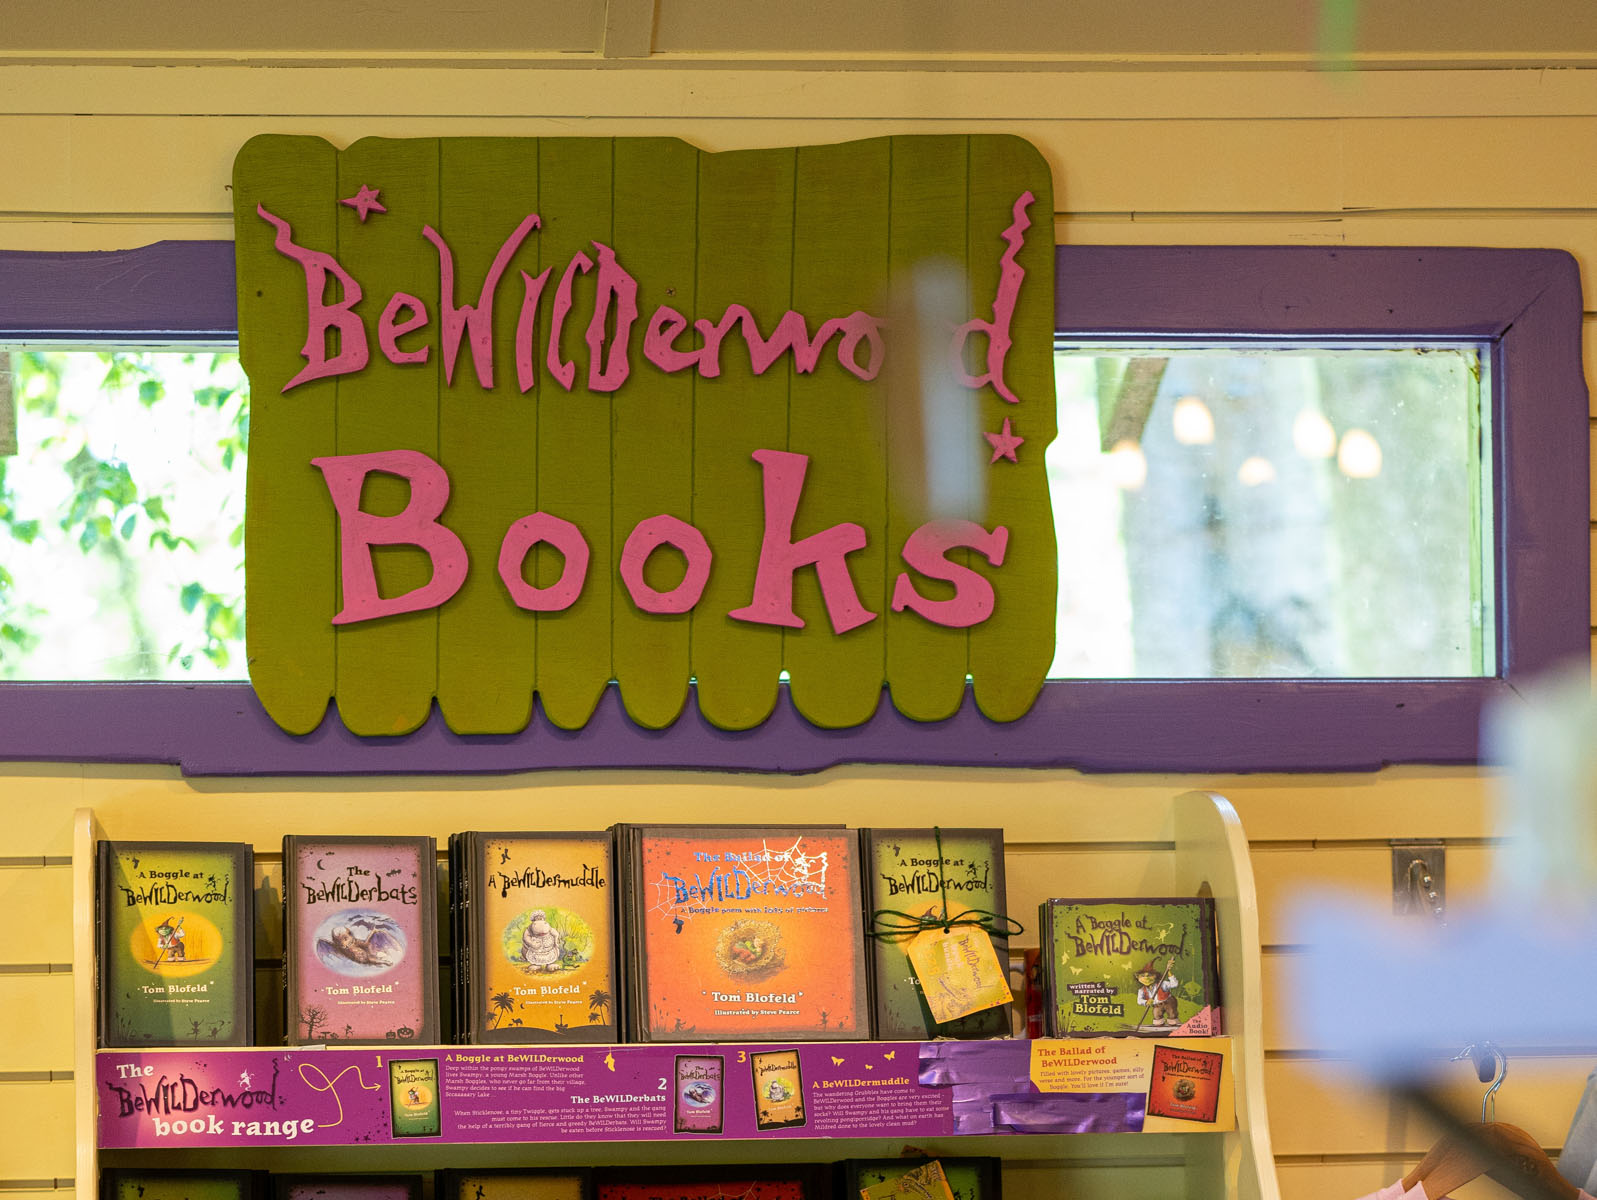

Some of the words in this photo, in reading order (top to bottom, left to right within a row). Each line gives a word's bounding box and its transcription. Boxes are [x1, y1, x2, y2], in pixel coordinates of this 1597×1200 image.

[257, 191, 1037, 402] BeWILDerwod
[311, 449, 1009, 636] Books
[694, 852, 720, 862] The
[149, 870, 190, 880] Boggle
[347, 866, 370, 876] The
[488, 875, 496, 888] A
[1076, 916, 1086, 934] A
[1084, 912, 1132, 933] Boggle
[1136, 916, 1152, 930] at
[142, 986, 165, 994] Tom
[168, 984, 207, 993] Blofeld
[326, 987, 349, 995] Tom
[353, 985, 392, 995] Blofeld
[513, 987, 536, 995] Tom
[541, 986, 580, 994] Blofeld
[712, 992, 741, 1001] Tom
[746, 992, 796, 1004] Blofeld
[1081, 995, 1109, 1004] Tom
[1075, 1004, 1121, 1015] Blofeld
[1060, 1047, 1092, 1055] Ballad
[376, 1055, 383, 1068] 1
[456, 1054, 491, 1063] Boggle
[508, 1054, 584, 1062] BeWILDerwood
[737, 1051, 746, 1063] 3
[1042, 1057, 1117, 1067] BeWILDerwood
[116, 1064, 154, 1079] The
[105, 1058, 279, 1118] BeWILDerwood
[657, 1078, 667, 1089] 2
[823, 1077, 909, 1088] BeWILDermuddle
[571, 1096, 590, 1104] The
[593, 1094, 666, 1104] BeWILDerbats
[152, 1115, 224, 1137] book
[231, 1118, 314, 1140] range
